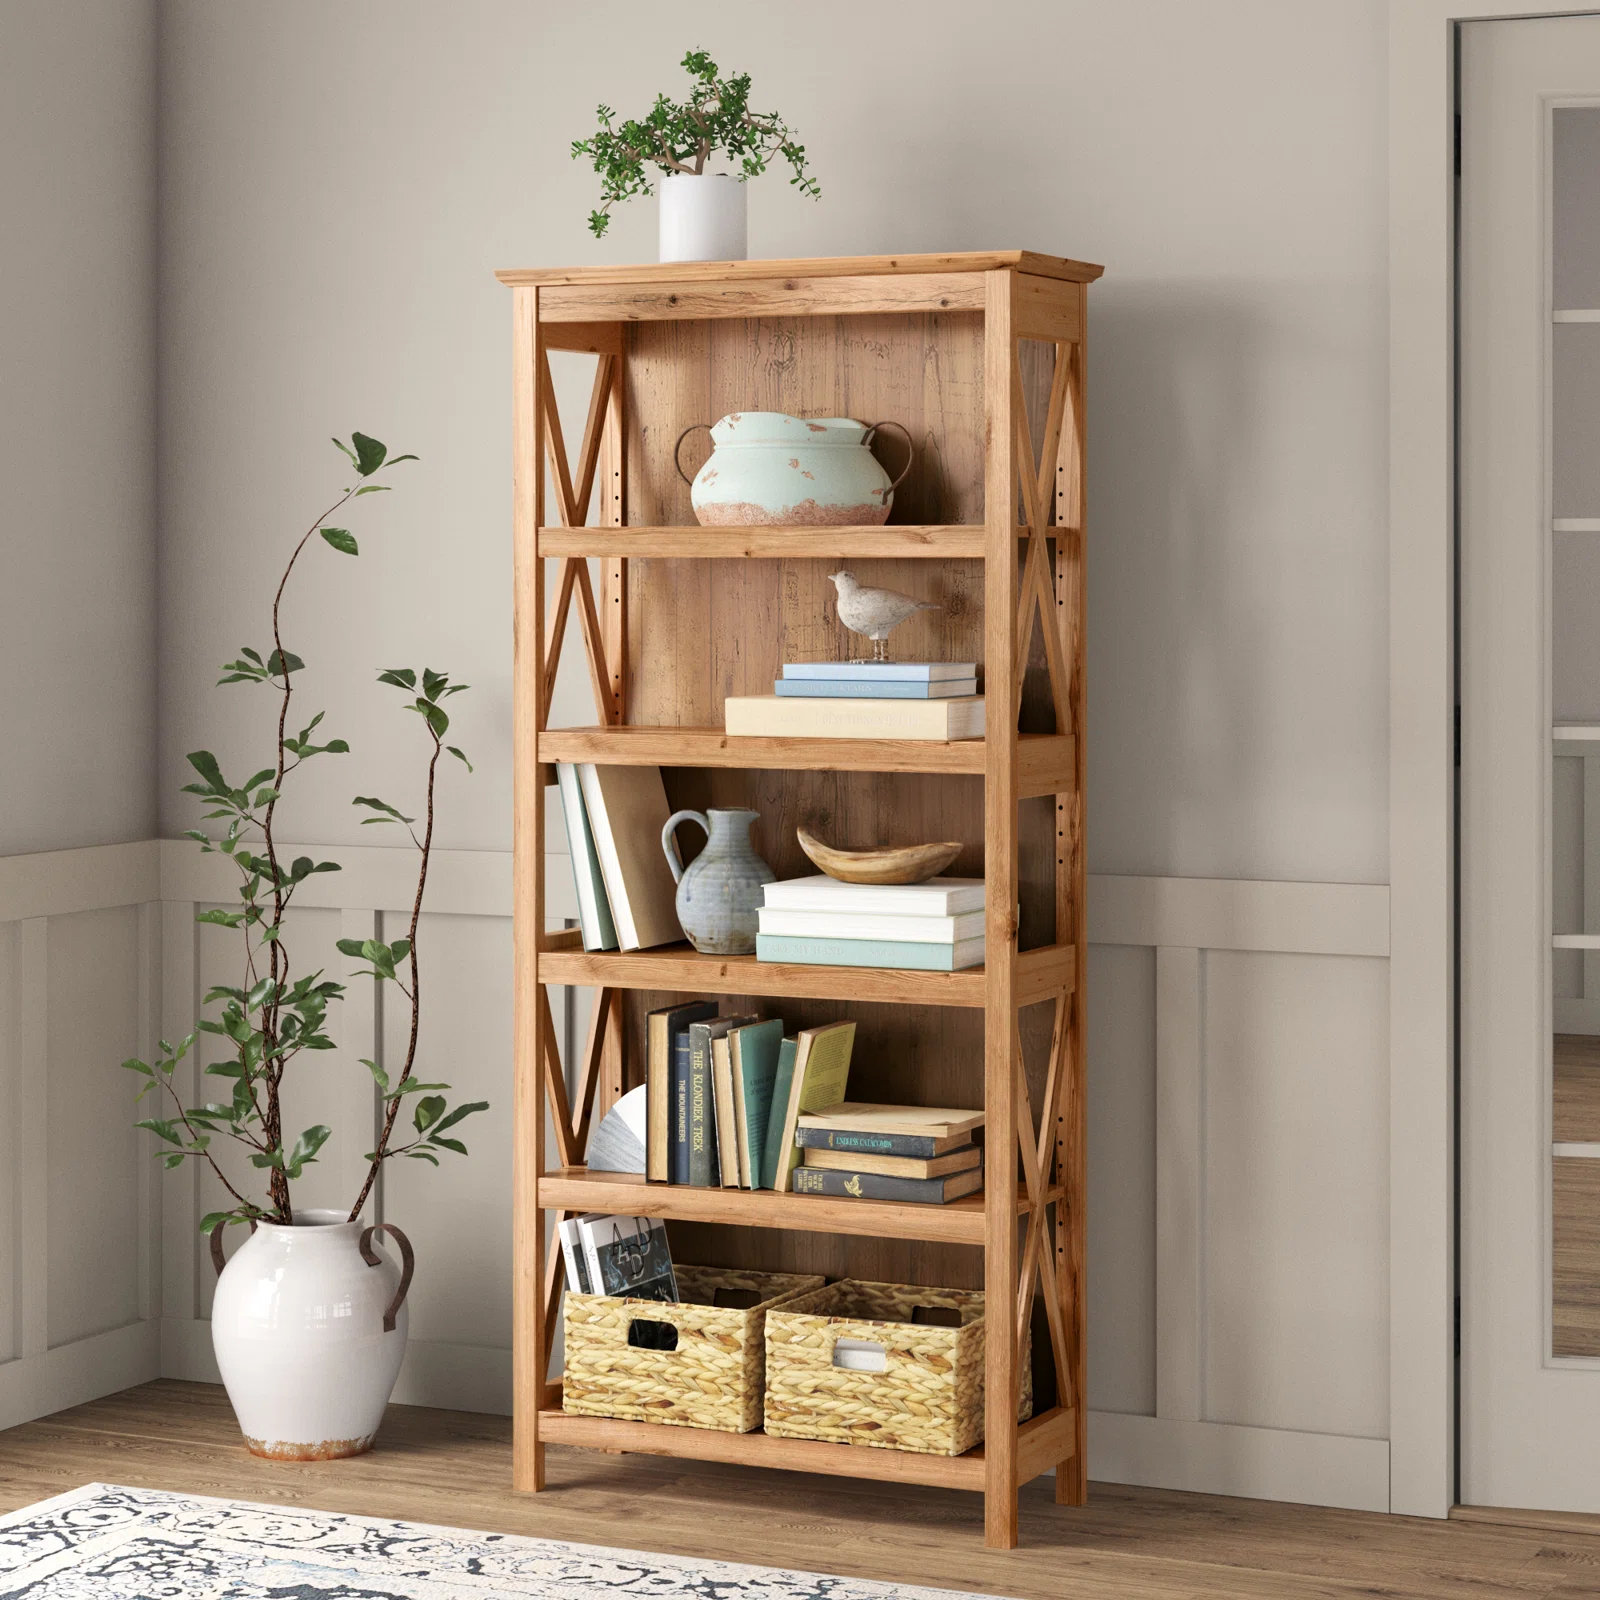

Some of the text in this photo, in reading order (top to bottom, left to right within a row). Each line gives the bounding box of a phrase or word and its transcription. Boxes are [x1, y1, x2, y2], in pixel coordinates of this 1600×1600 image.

[678, 1080, 686, 1143] THE MOUNTAINEERS
[693, 1050, 704, 1152] THE KLONDIEK TREK
